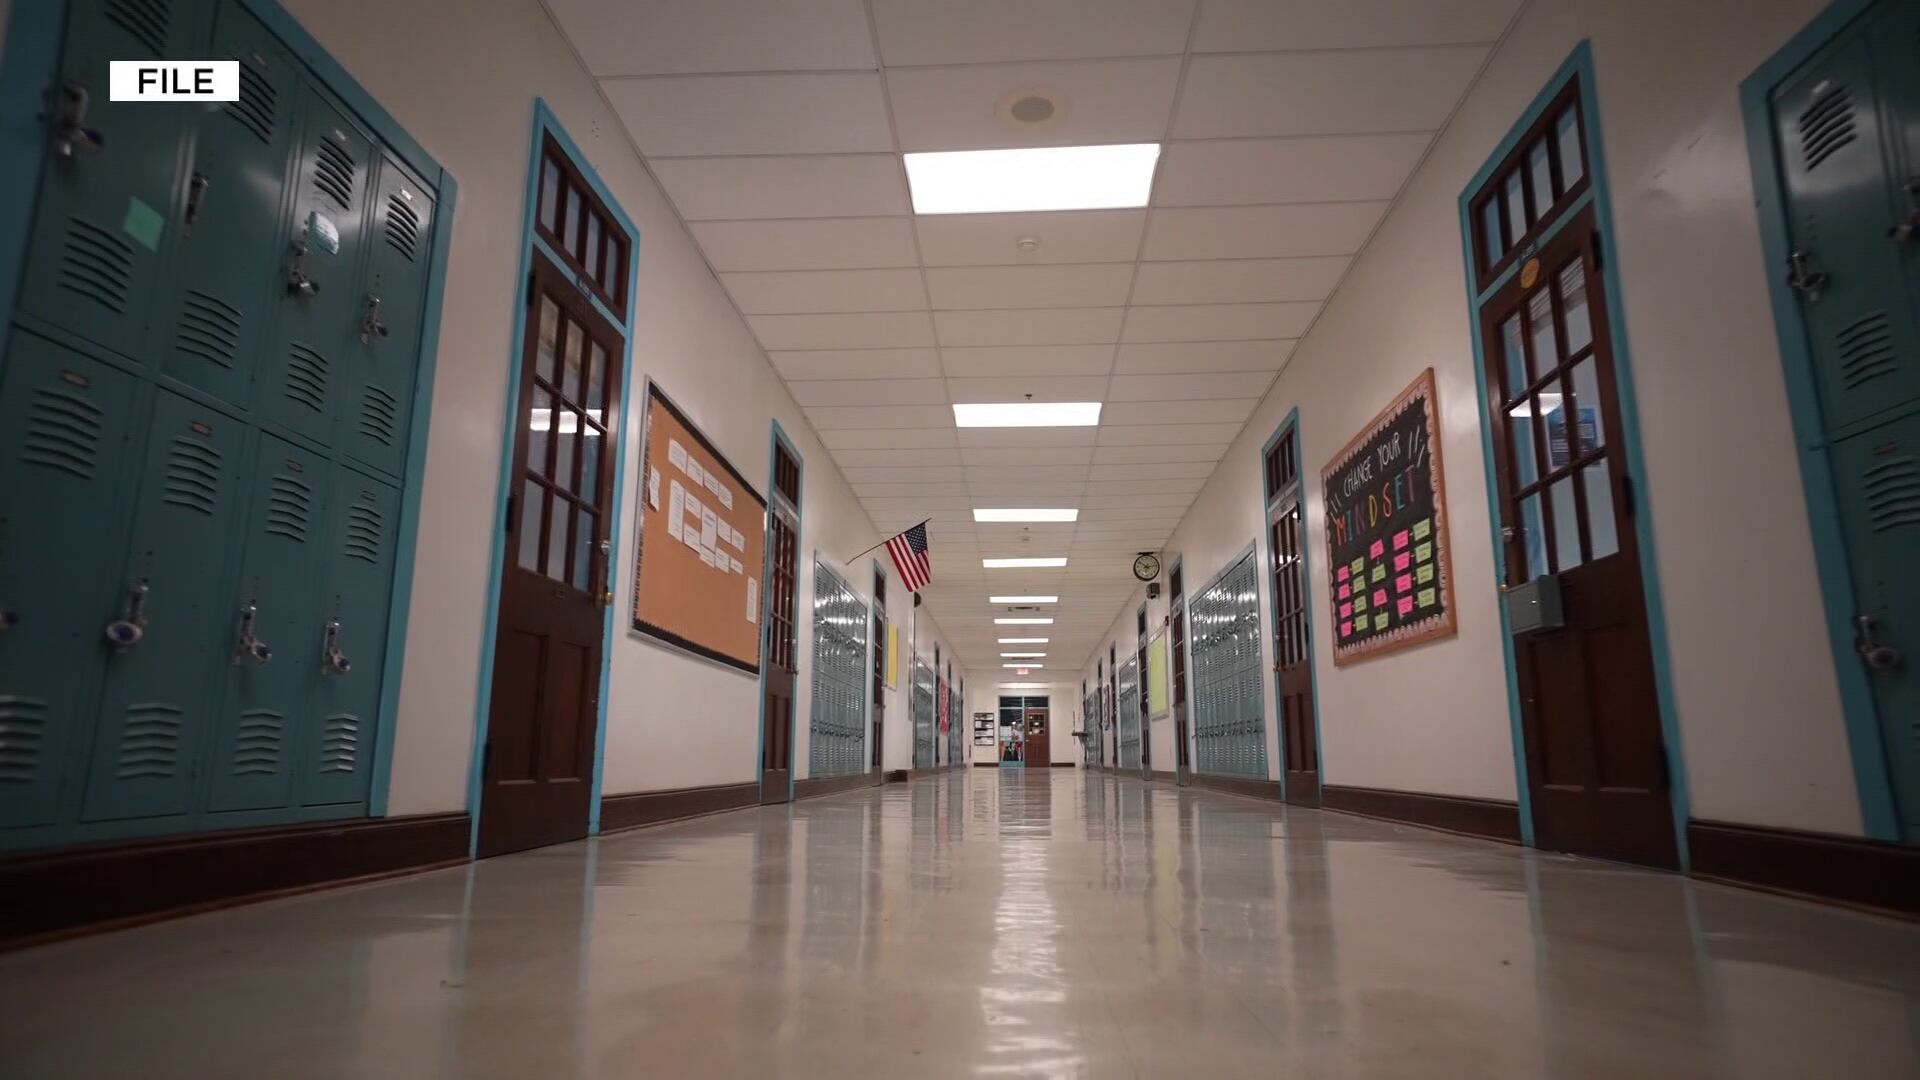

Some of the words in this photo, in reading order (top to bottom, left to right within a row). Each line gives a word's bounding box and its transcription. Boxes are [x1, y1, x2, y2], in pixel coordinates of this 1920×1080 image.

[1343, 455, 1373, 497] CHANGE
[1377, 432, 1401, 472] YOUR
[1336, 465, 1414, 546] MINDSET
